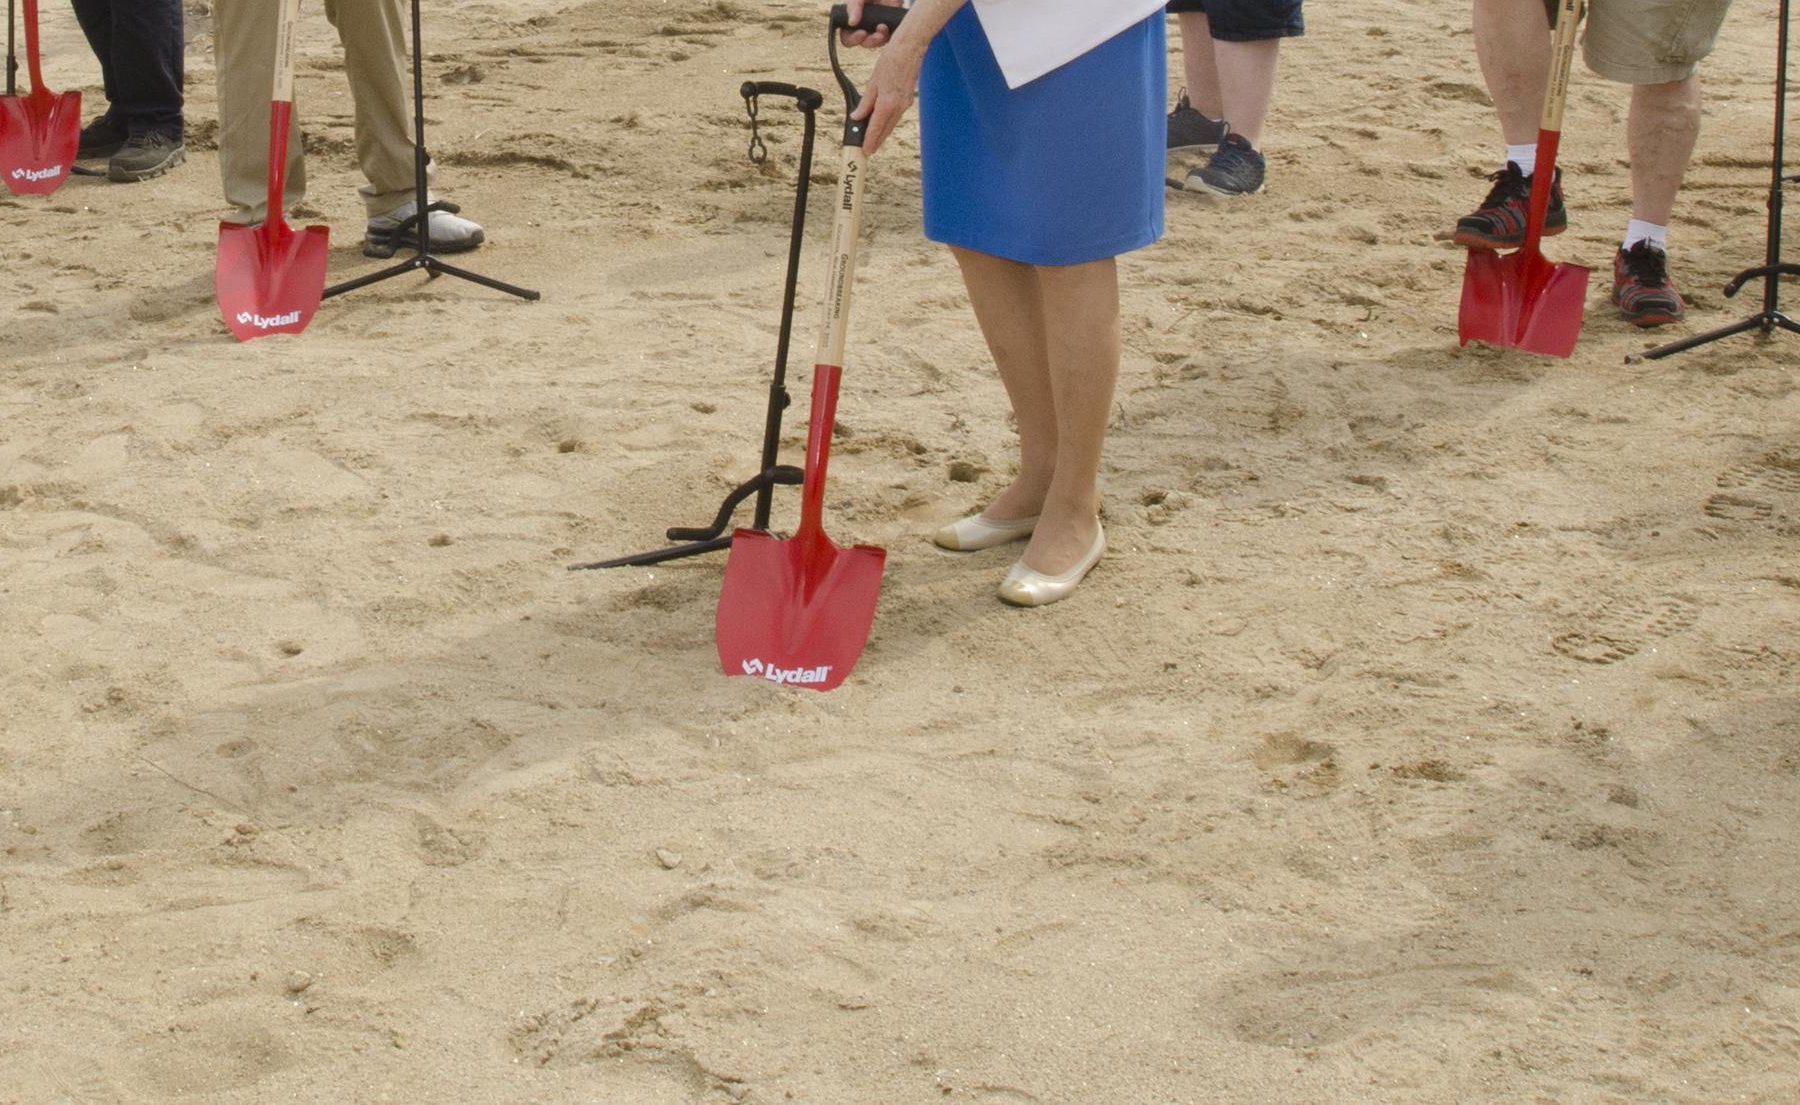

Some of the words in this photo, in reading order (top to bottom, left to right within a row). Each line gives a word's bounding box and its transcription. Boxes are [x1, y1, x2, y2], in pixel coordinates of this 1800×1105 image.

[26, 164, 61, 182] Lydall
[840, 174, 856, 210] Lydall
[832, 253, 848, 319] GROUNDBREAKING
[254, 311, 299, 329] Lydall
[765, 663, 828, 684] Lydall
